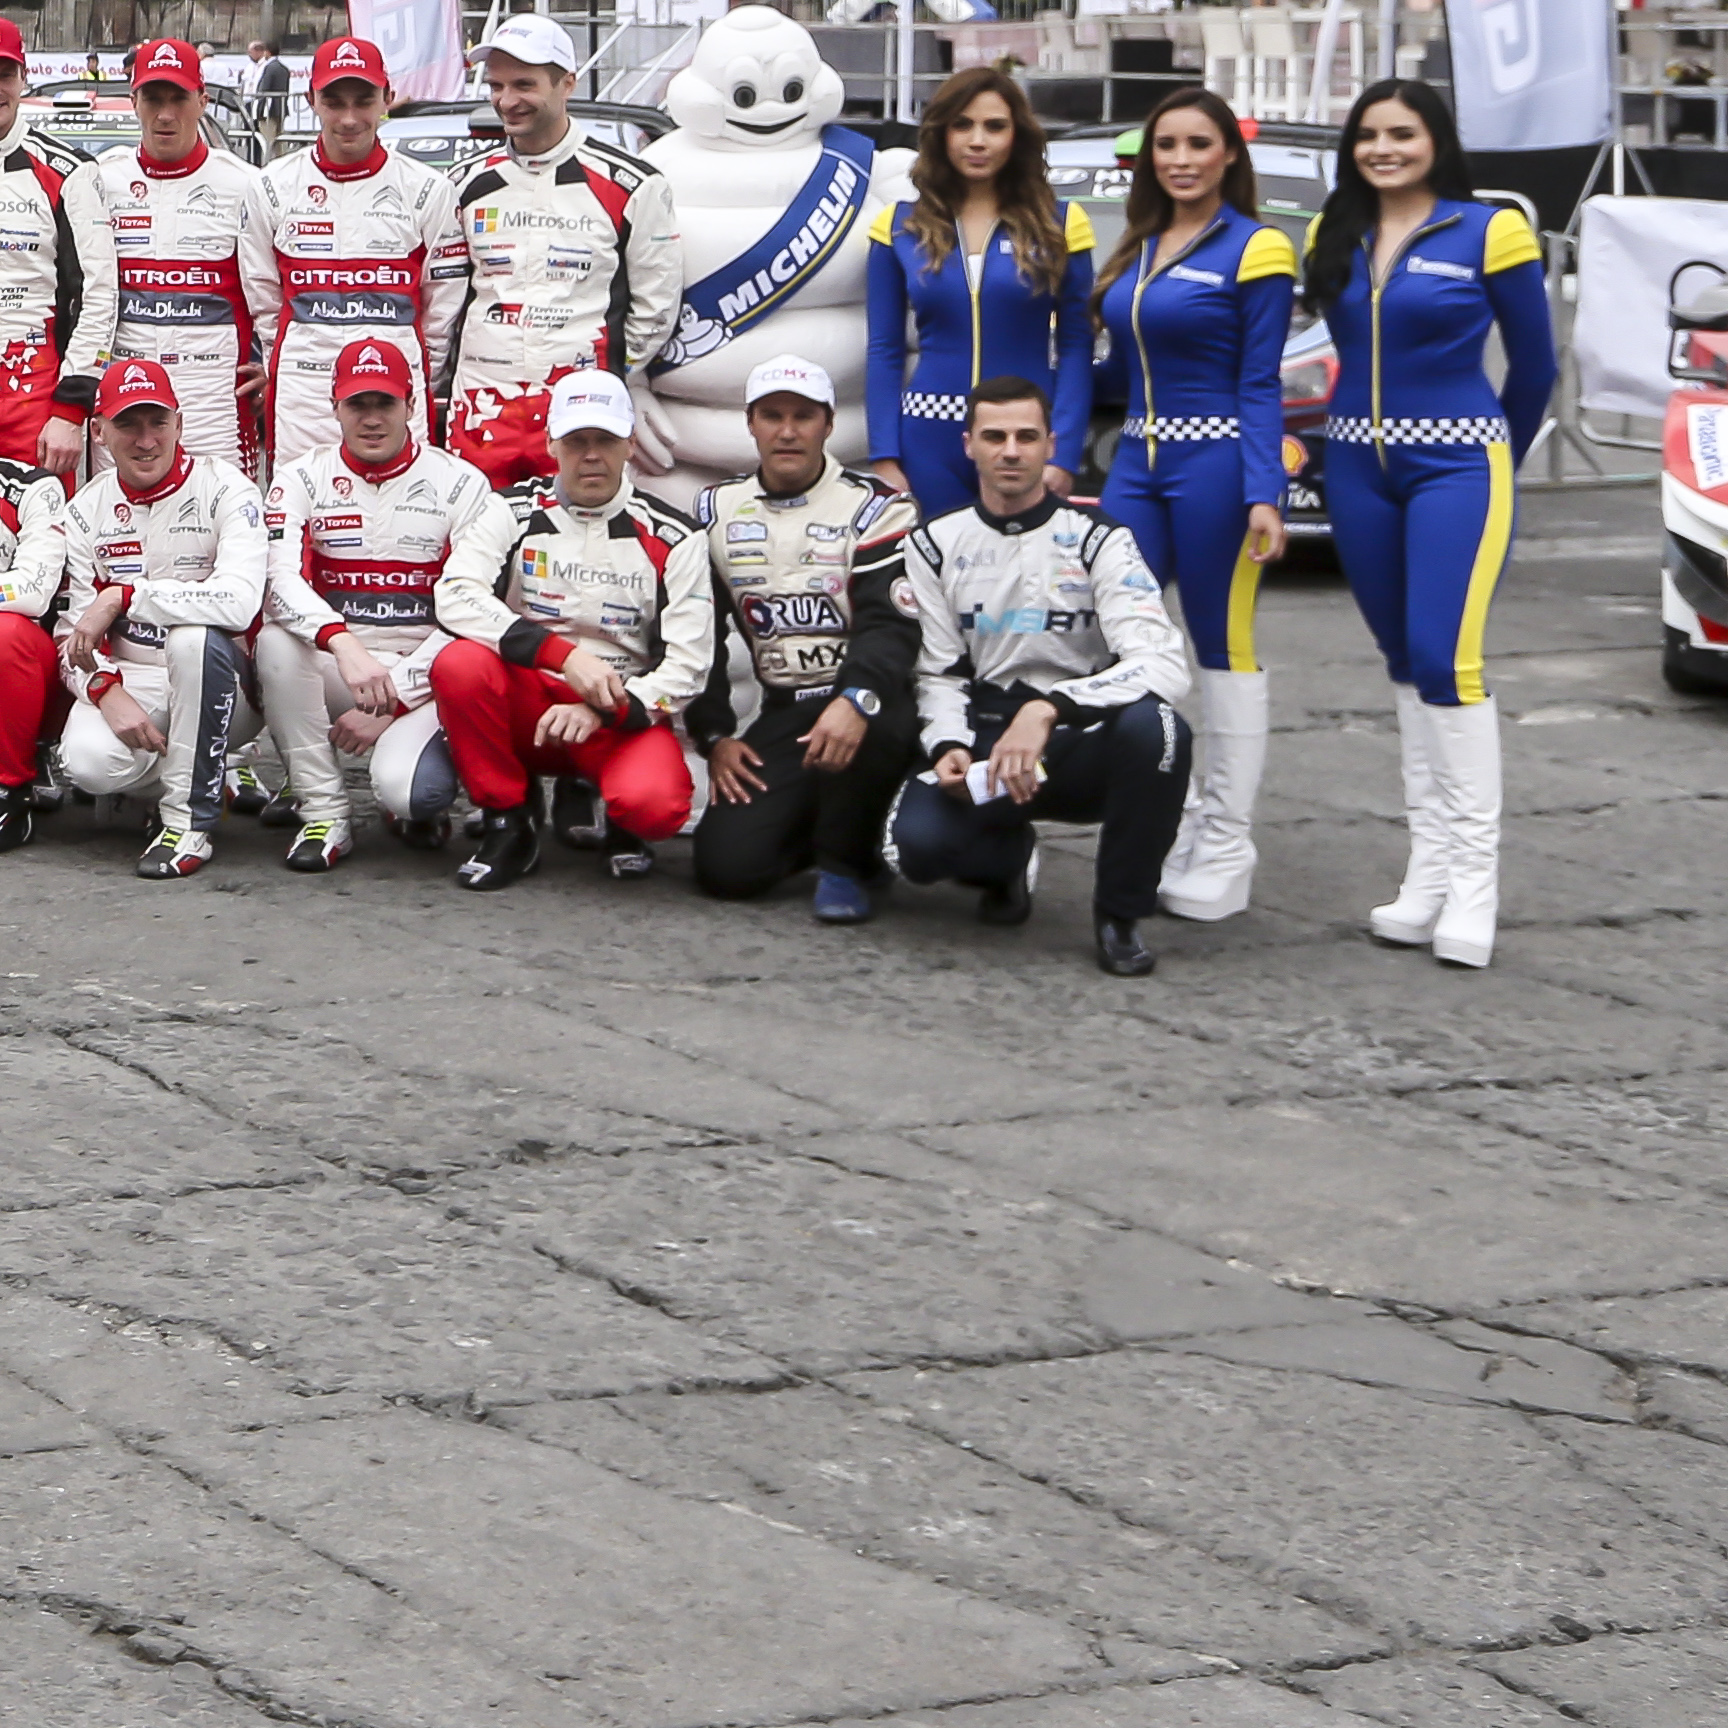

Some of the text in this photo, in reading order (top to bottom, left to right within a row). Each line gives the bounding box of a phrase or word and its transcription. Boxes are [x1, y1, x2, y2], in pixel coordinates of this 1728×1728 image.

[120, 218, 150, 227] TOTAL
[299, 224, 332, 233] TOTAL
[502, 210, 594, 232] Microsoft
[717, 159, 859, 323] MICHELIN
[121, 266, 221, 286] ITROËN
[290, 265, 411, 286] CITROËN
[309, 302, 397, 320] Abu Dhabi
[326, 518, 361, 527] TOTAL
[552, 559, 644, 590] Microsoft
